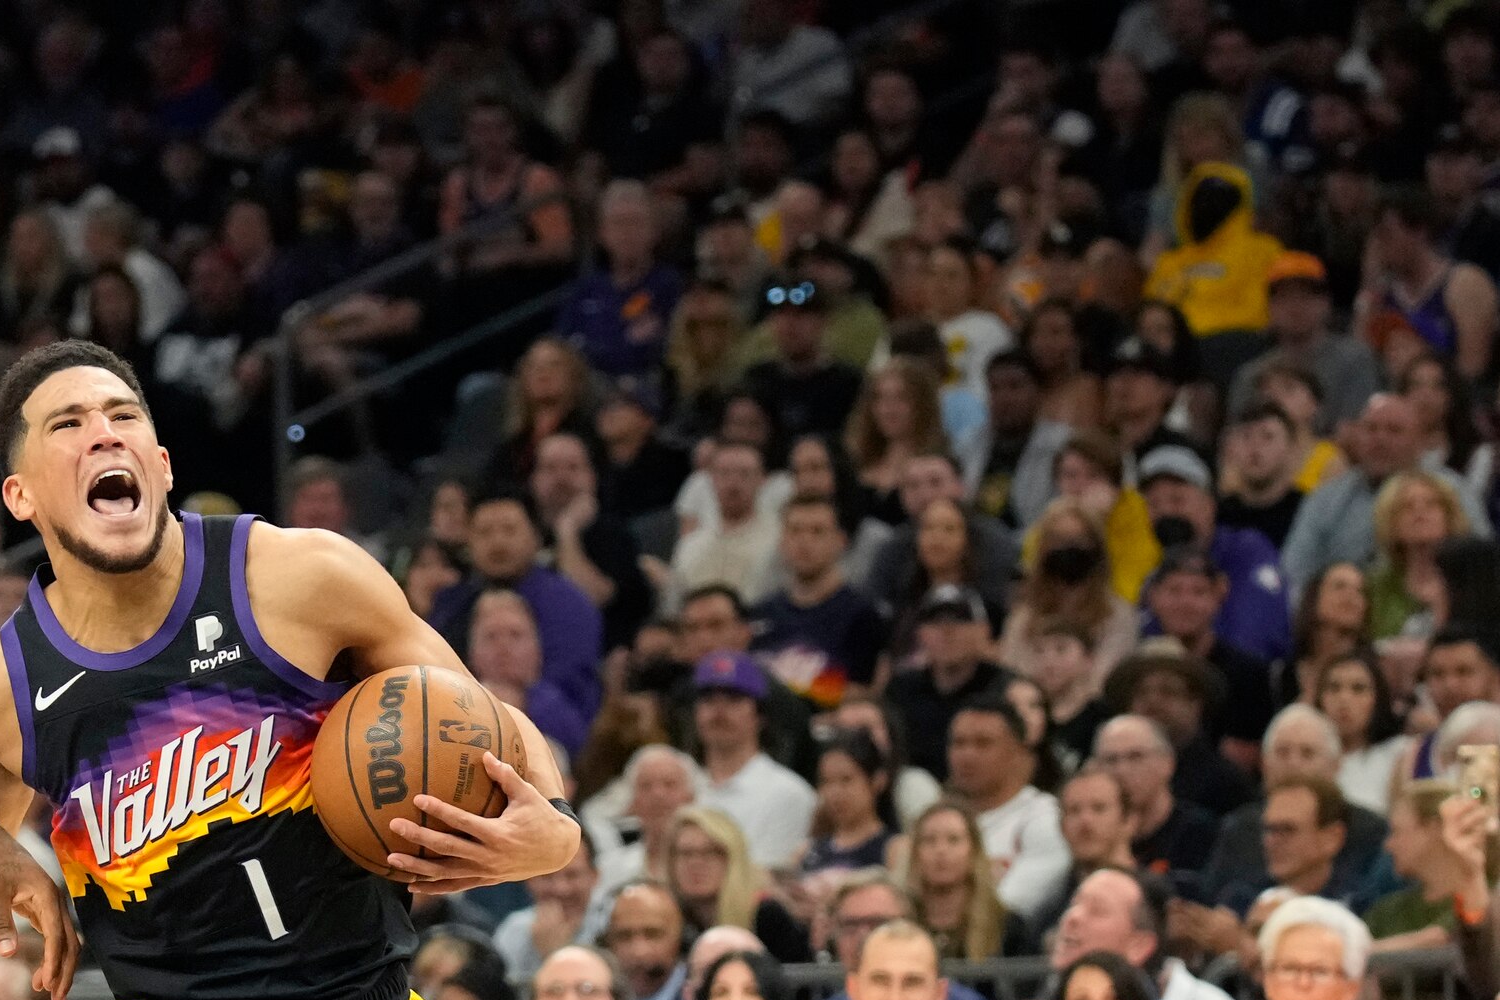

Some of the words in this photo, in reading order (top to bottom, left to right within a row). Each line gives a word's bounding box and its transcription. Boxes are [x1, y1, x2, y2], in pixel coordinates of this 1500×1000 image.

[190, 645, 241, 673] PayPal
[117, 760, 153, 795] THE
[366, 674, 411, 810] Wilson
[71, 714, 284, 867] Valley
[239, 858, 289, 942] 1
